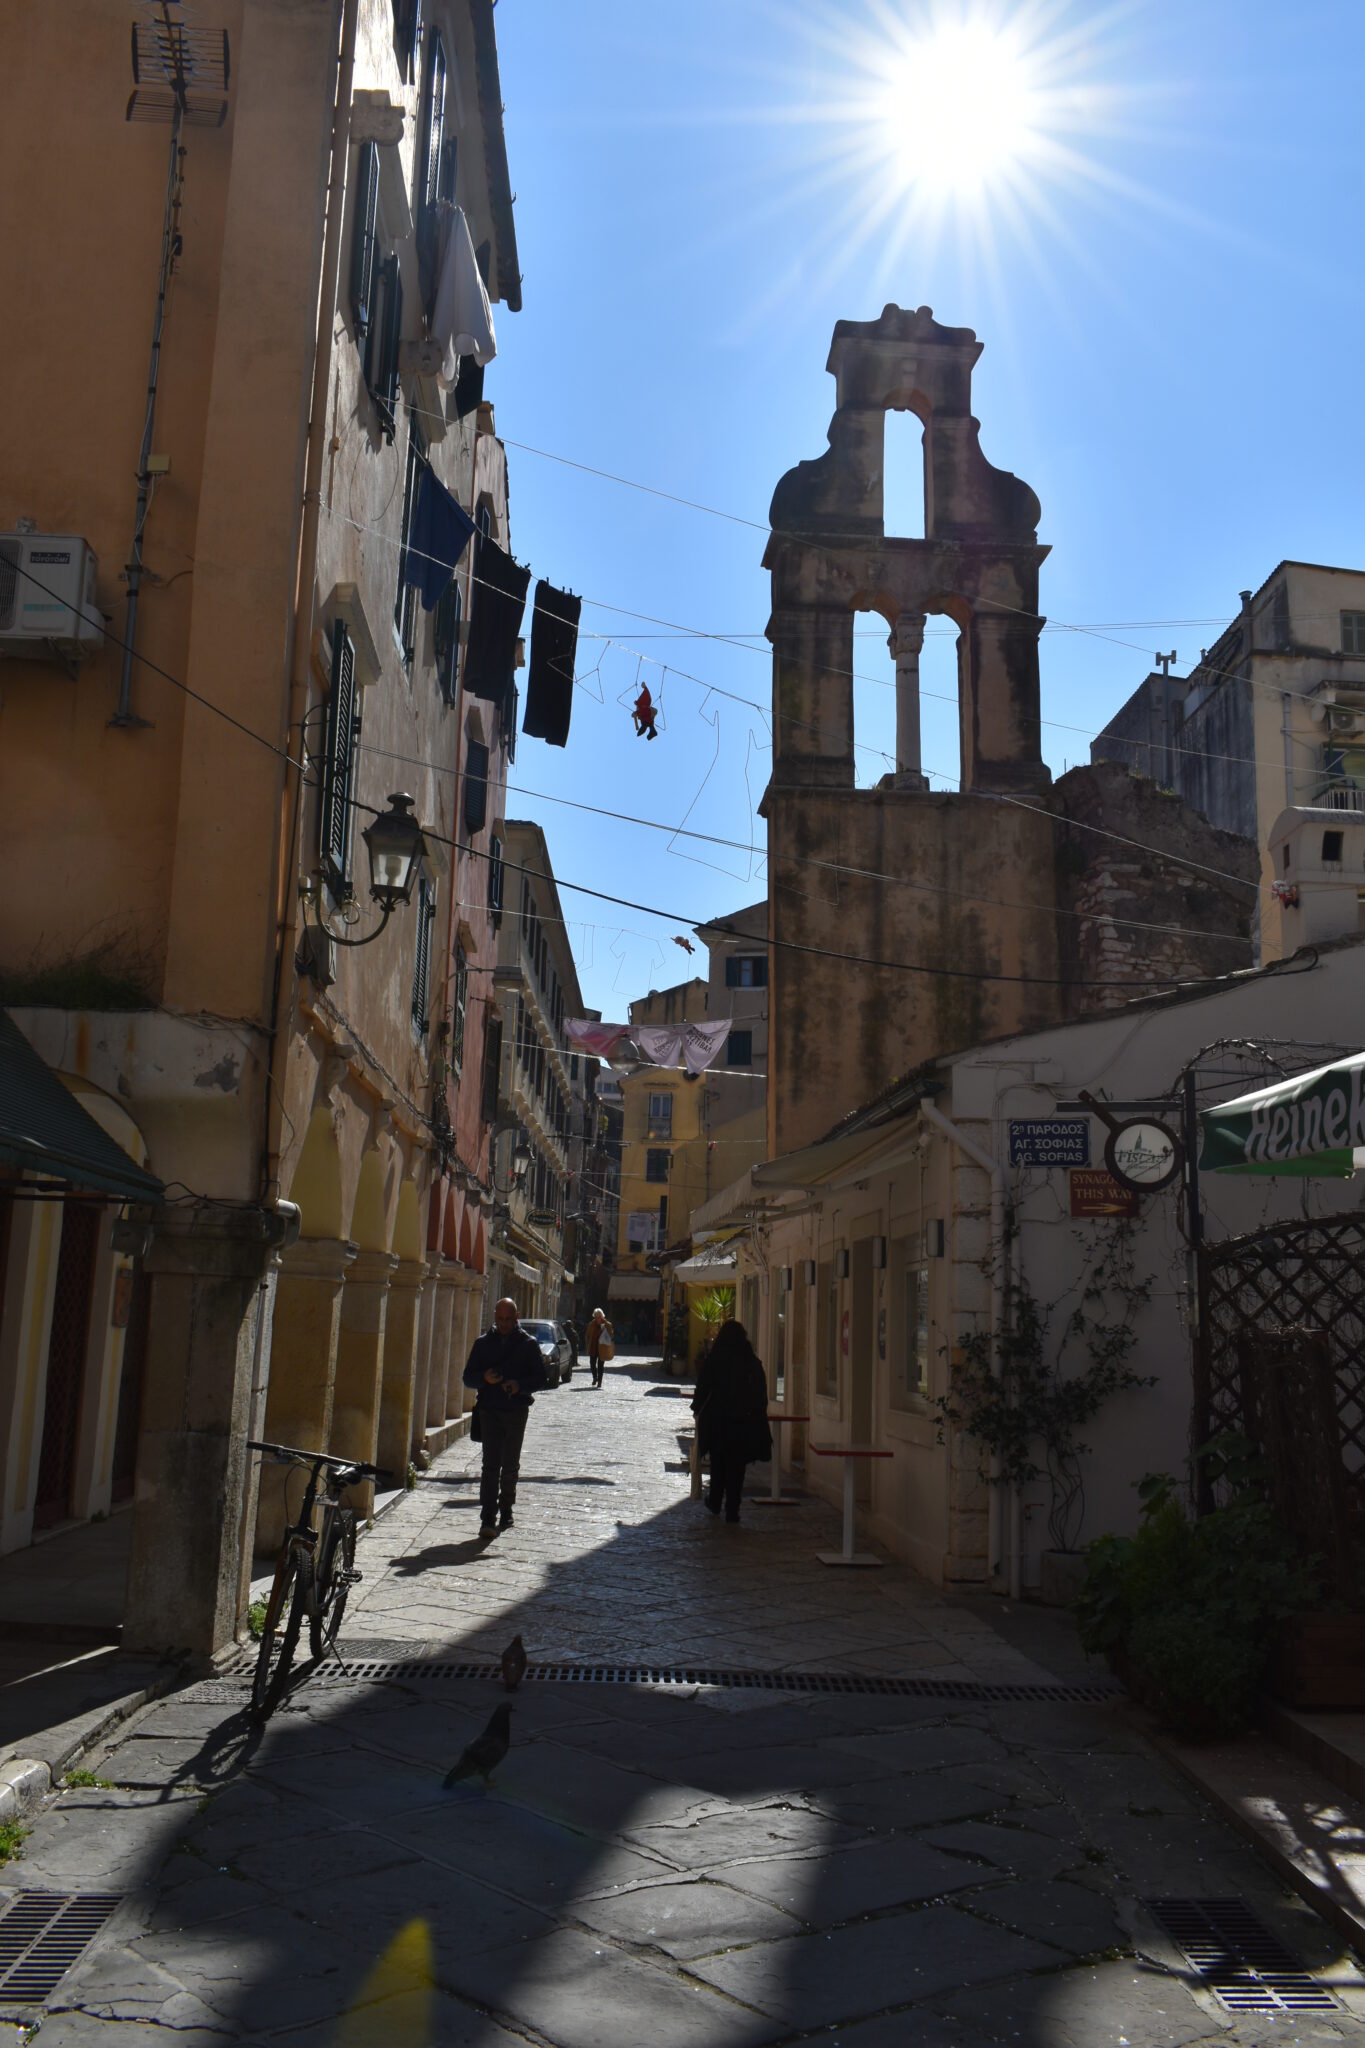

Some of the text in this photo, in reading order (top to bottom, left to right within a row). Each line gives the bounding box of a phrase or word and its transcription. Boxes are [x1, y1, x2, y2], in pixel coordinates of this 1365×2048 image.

[1027, 1124, 1085, 1135] ΠΑΡΟΔΟΣ
[1014, 1139, 1084, 1149] ΑΓ. ΣΟΦΙΑΣ
[1016, 1152, 1084, 1162] AG. SOFIAS
[1072, 1174, 1118, 1185] SYNAGO
[1074, 1188, 1132, 1199] THIS WAY
